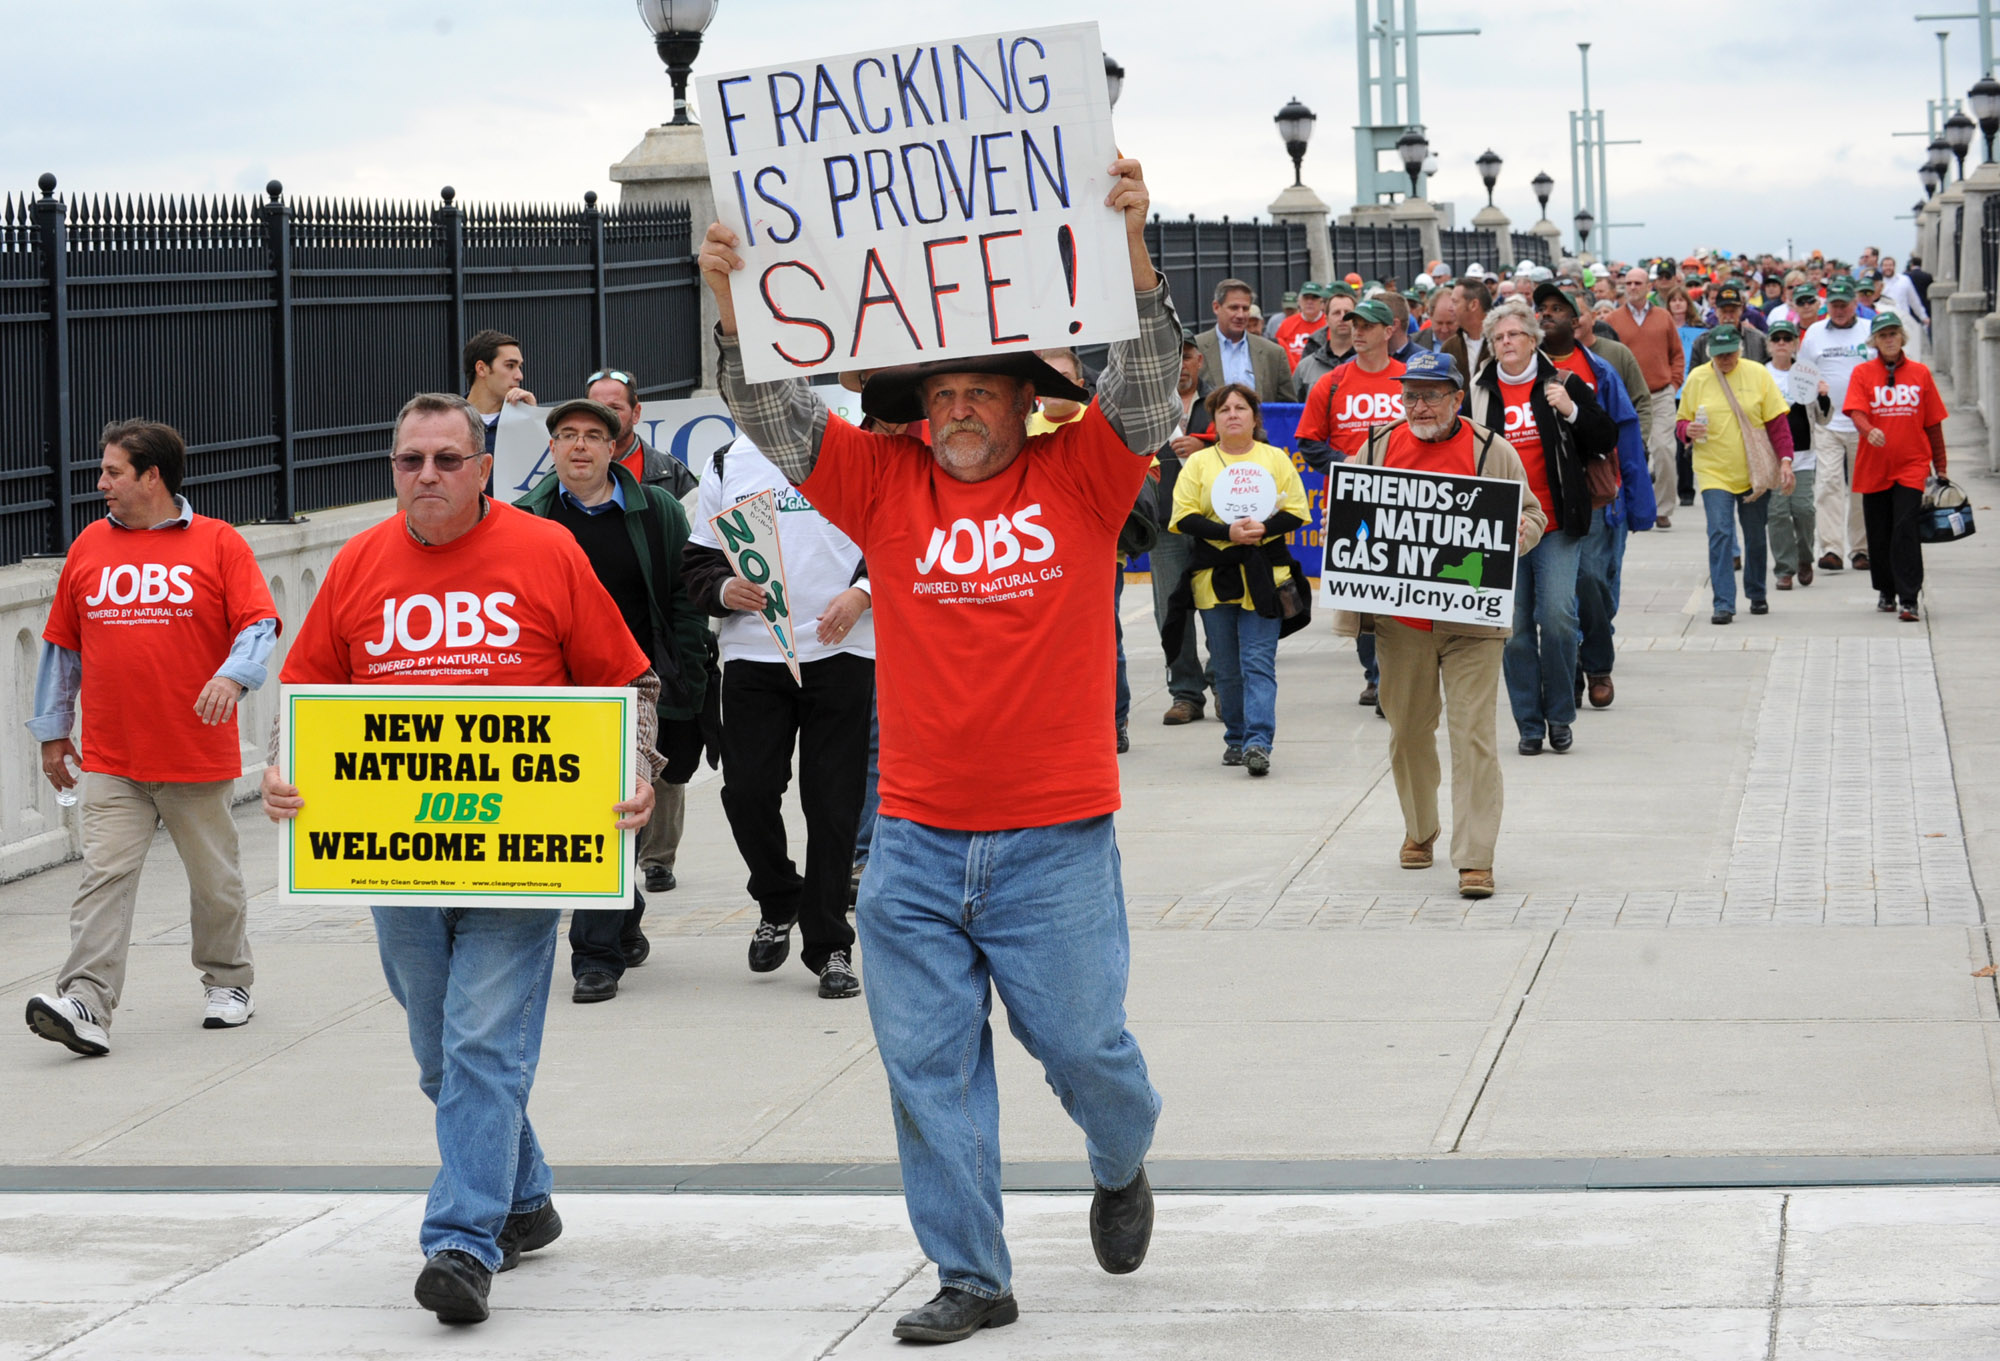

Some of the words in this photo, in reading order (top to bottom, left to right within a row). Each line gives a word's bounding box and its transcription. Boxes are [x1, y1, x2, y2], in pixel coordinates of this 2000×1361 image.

[717, 36, 1051, 156] FRACKING
[732, 165, 802, 247] IS
[823, 125, 1071, 239] PROVEN
[1336, 393, 1406, 421] JOBS
[1870, 384, 1921, 408] JOBS
[1229, 468, 1262, 477] NATURAL
[1234, 477, 1251, 485] GAS
[778, 487, 790, 500] of
[787, 498, 811, 510] GAS
[1230, 485, 1259, 494] MEANS
[1336, 471, 1453, 511] FRIENDS
[1455, 487, 1482, 511] of
[1225, 503, 1258, 512] JOBS
[915, 503, 1055, 575] JOBS
[1374, 508, 1511, 551] NATURAL
[1331, 538, 1389, 573] GAS
[1397, 544, 1439, 577] NY
[85, 563, 194, 607] JOBS
[913, 582, 959, 594] POWERED
[961, 582, 977, 593] BY
[981, 571, 1038, 592] NATURAL
[1040, 565, 1063, 581] GAS
[938, 587, 1034, 604] www.energycitizens.org
[1328, 580, 1503, 618] www.jlcny.org
[87, 609, 119, 619] POWERED
[121, 609, 132, 617] BY
[134, 608, 173, 617] NATURAL
[176, 608, 193, 617] GAS
[364, 591, 520, 656] JOBS
[368, 658, 415, 675] POWERED
[418, 656, 433, 667] BY
[437, 654, 495, 665] NATURAL
[498, 653, 522, 664] GAS
[394, 667, 489, 676] www.energycitizens.org
[364, 714, 444, 742] NEW
[455, 714, 551, 743] YORK
[334, 752, 500, 781] NATURAL
[512, 753, 580, 783] GAS
[414, 792, 503, 823] JOBS
[309, 832, 486, 862] WELCOME
[498, 834, 605, 864] HERE!
[472, 880, 562, 888] www.cleangrowthnow.org
